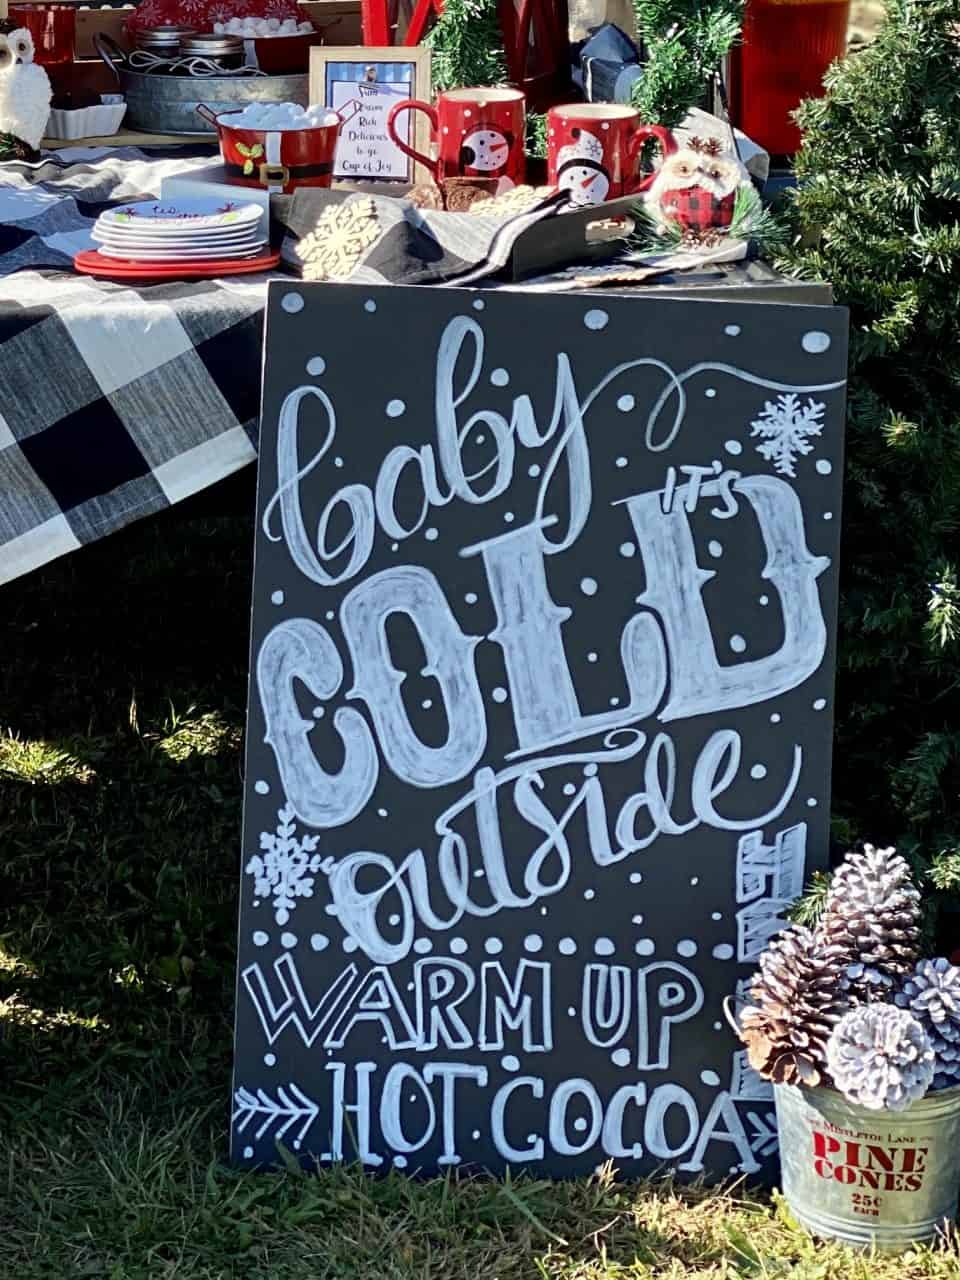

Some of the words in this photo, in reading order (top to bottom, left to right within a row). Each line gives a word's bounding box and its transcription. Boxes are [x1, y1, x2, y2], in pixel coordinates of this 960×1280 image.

[342, 160, 360, 172] Cup
[375, 160, 392, 173] Joy
[262, 316, 685, 586] baby
[661, 460, 740, 519] IT'S
[257, 475, 831, 827] COLD
[328, 728, 802, 963] outside
[242, 952, 552, 1052] WARM
[583, 960, 705, 1070] UP
[320, 1061, 488, 1166] HOT
[490, 1077, 762, 1173] COCOA
[812, 1131, 928, 1173] PINE
[814, 1159, 924, 1192] CONES
[853, 1206, 880, 1216] EACH
